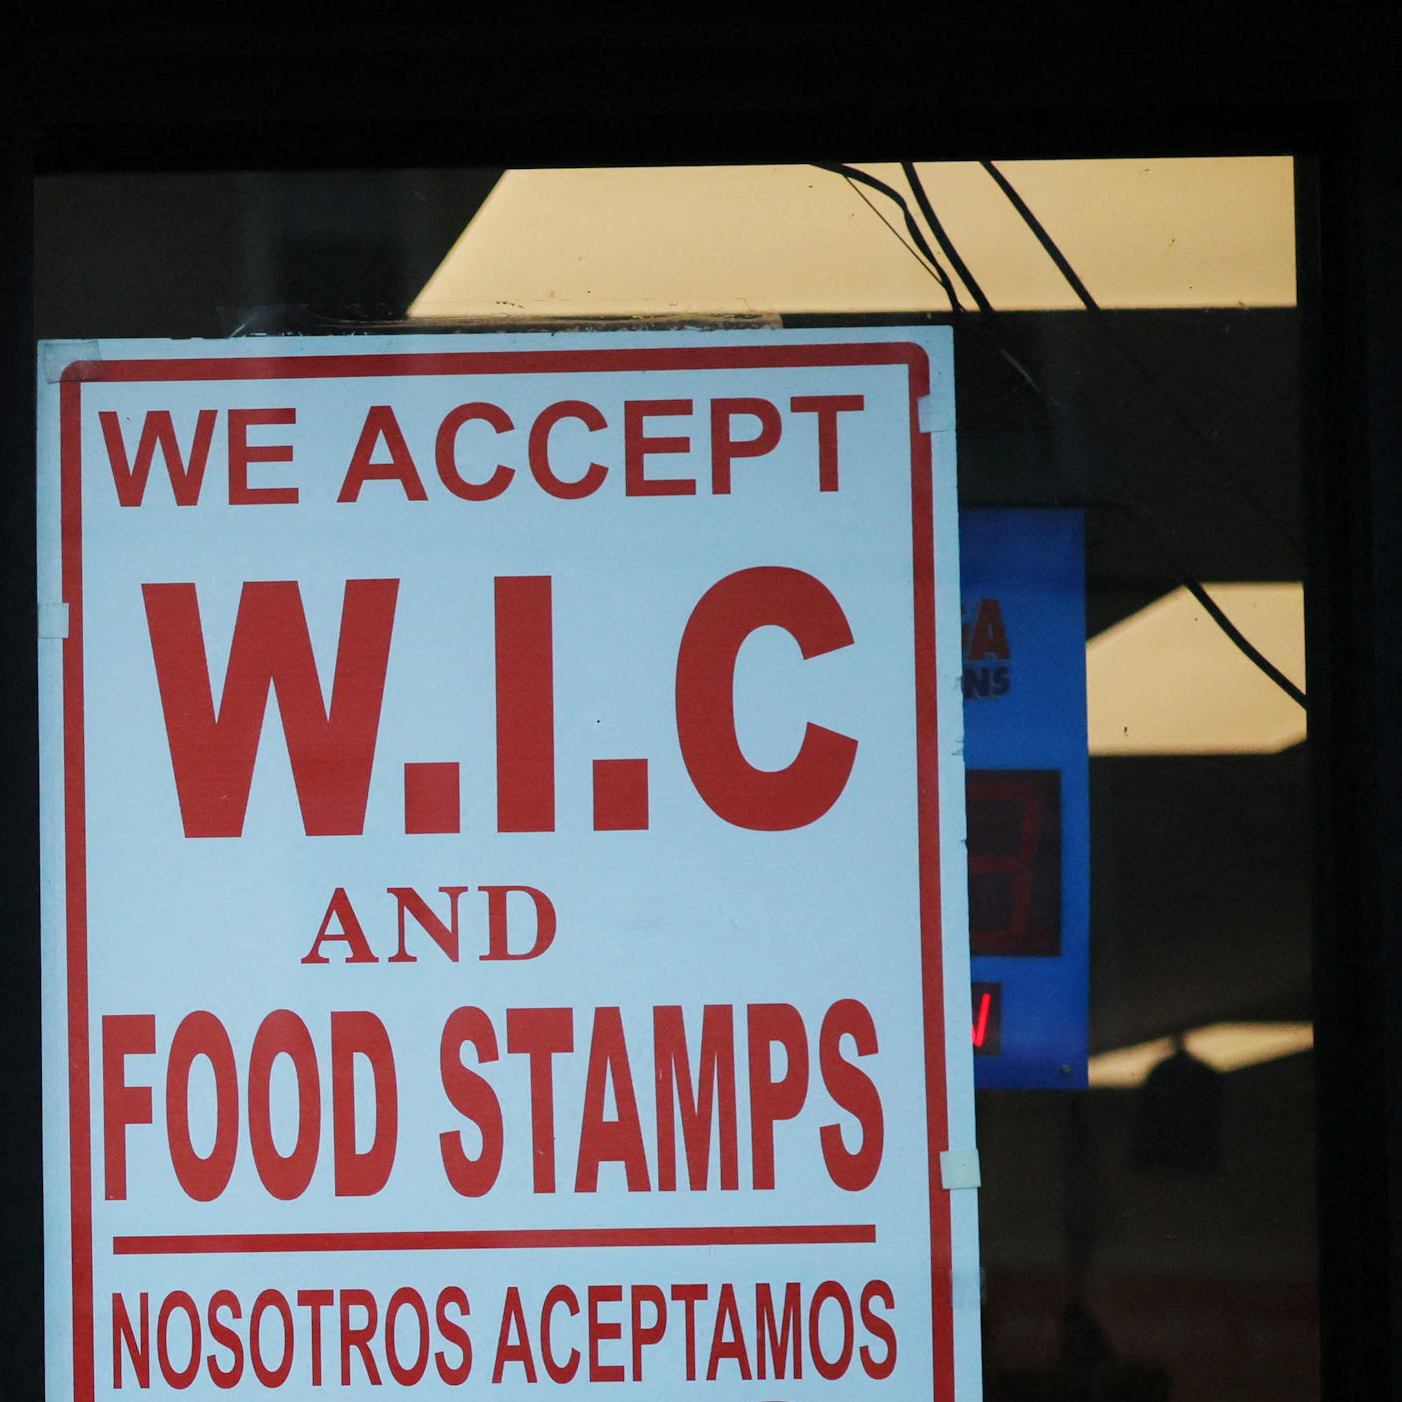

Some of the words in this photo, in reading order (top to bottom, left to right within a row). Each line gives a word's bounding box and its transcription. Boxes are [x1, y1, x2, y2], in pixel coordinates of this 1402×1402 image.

[99, 406, 299, 507] WE
[337, 394, 865, 503] ACCEPT
[141, 565, 859, 838] W.I.C
[301, 885, 558, 964] AND
[101, 1009, 398, 1202] FOOD
[439, 998, 884, 1198] STAMPS
[111, 1286, 473, 1389] NOSOTROS
[492, 1279, 898, 1385] ACEPTAMOS
